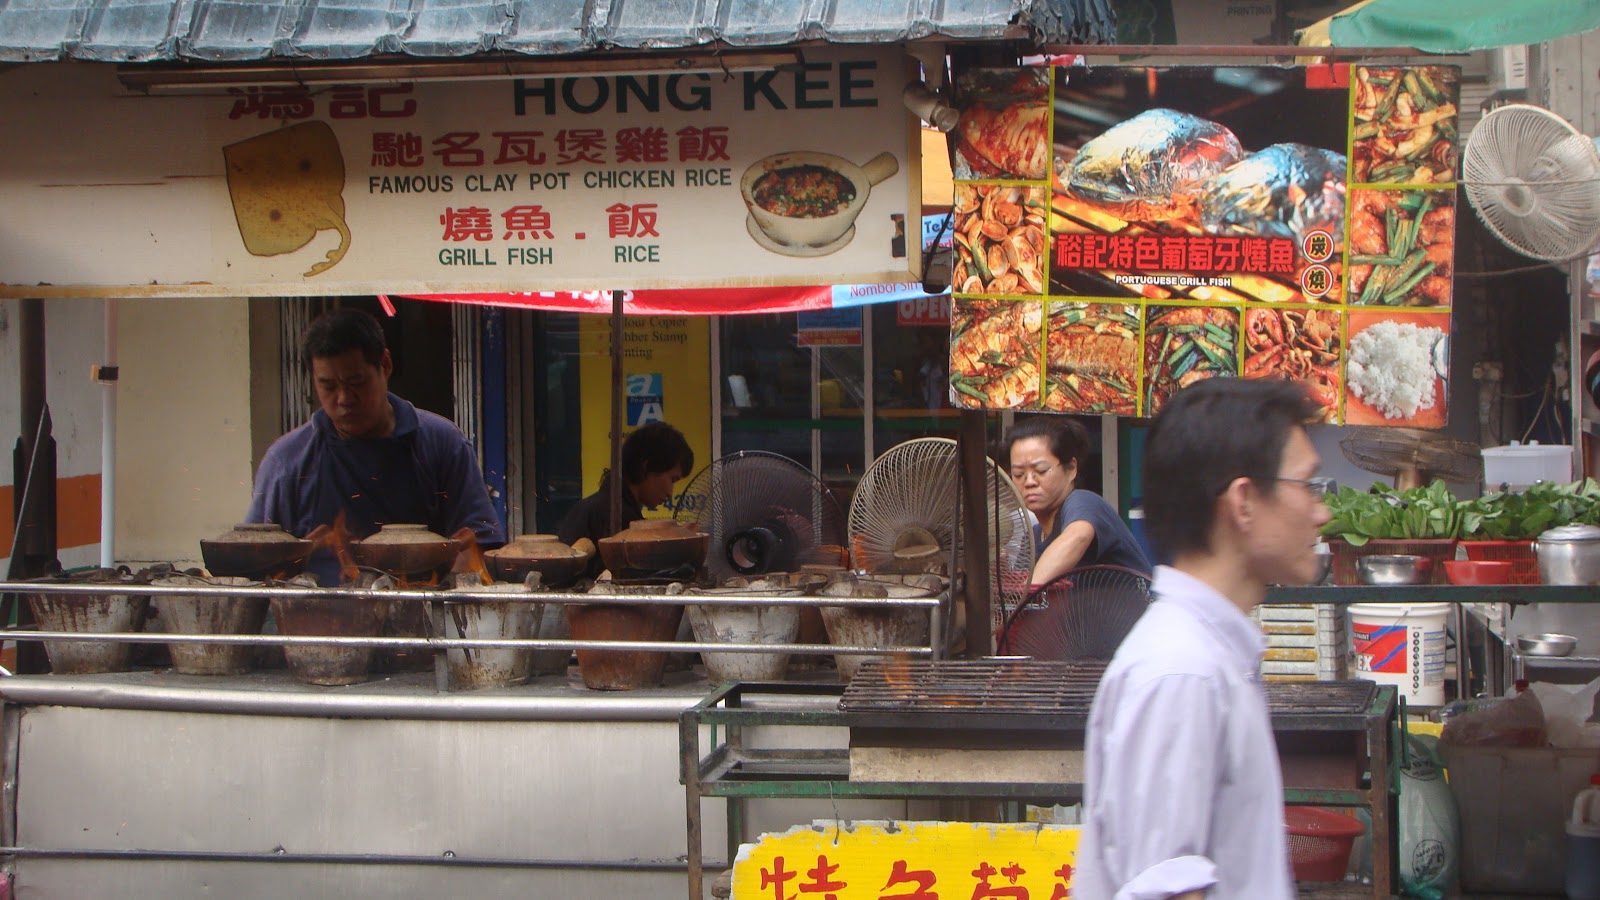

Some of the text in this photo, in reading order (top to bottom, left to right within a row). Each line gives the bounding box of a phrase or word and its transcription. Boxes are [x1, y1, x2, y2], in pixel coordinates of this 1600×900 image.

[514, 61, 879, 115] HONG KEE
[370, 126, 730, 168] 馳名瓦煲雞飯
[369, 168, 732, 194] FAMOUS CLAY POT CHICKEN RICE
[438, 245, 660, 266] GRILL FISH RICE
[1056, 234, 1295, 273] 裕記特色葡萄牙燒魚
[1115, 275, 1231, 287] PORTUGUESE GRILL FISH
[900, 298, 950, 319] OPEN
[649, 315, 688, 331] Copier
[651, 330, 688, 345] Stamp
